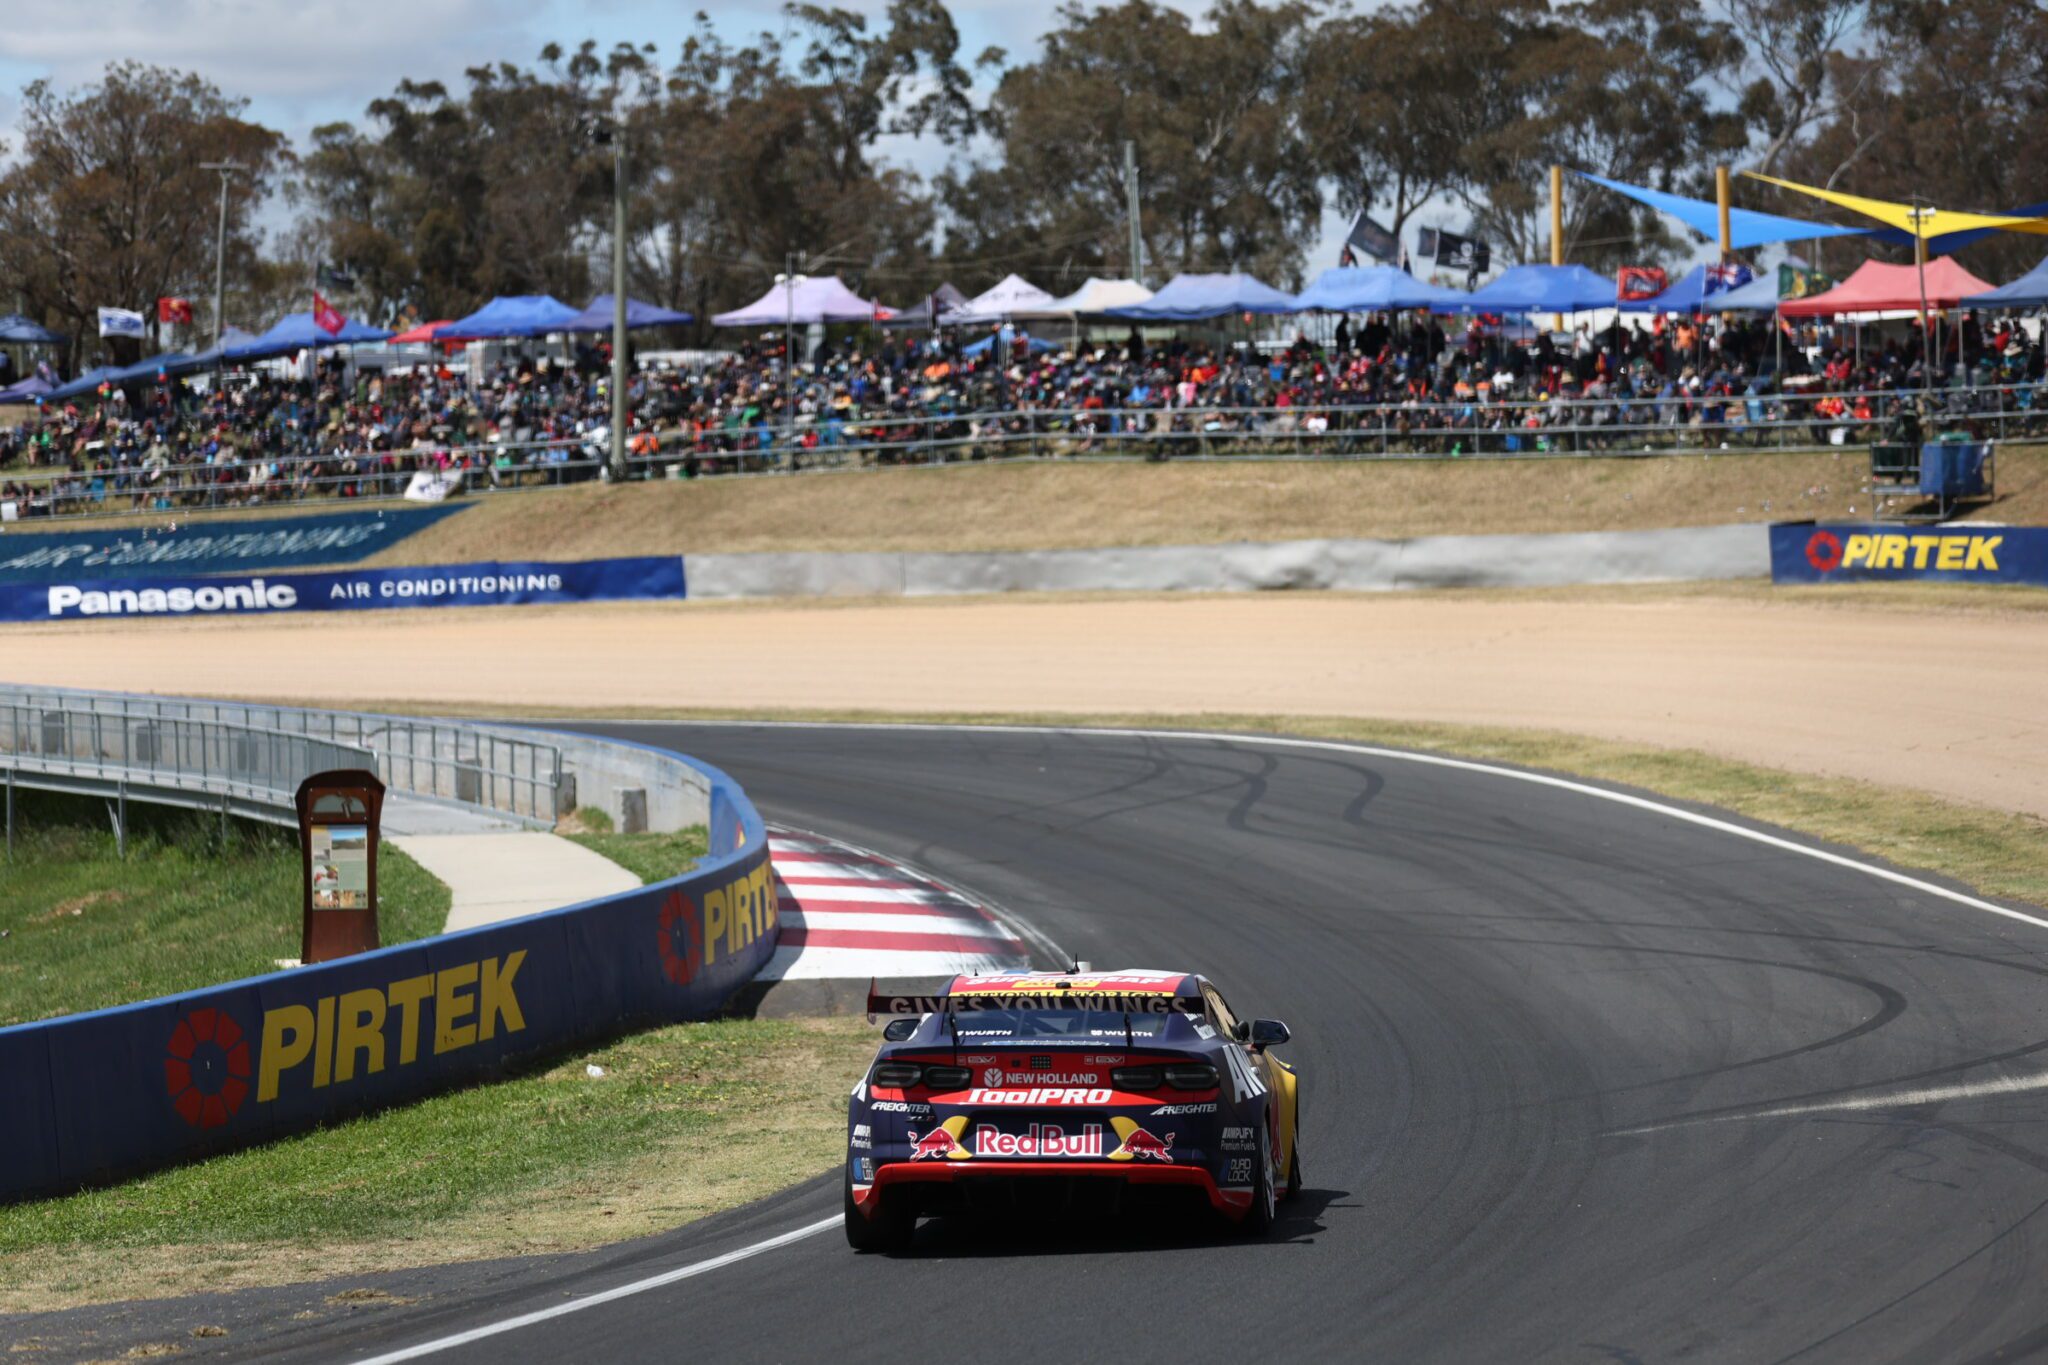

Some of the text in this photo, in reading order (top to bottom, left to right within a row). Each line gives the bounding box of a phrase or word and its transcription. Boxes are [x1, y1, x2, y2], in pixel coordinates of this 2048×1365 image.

[1841, 533, 2004, 571] PIRTEK
[48, 574, 563, 616] Panasonic AIR CONDITIONING
[703, 857, 778, 966] PIRTE
[889, 996, 1189, 1014] GIVES YOU WINGS
[256, 948, 528, 1103] PIRTEK
[1006, 1073, 1098, 1085] NEW HOLLAND
[873, 1101, 931, 1114] FREIGHTER
[1157, 1103, 1218, 1116] FREIGHTER
[976, 1122, 1103, 1156] Red Bull
[1225, 1127, 1254, 1139] AMPLIFY
[1227, 1170, 1251, 1182] LOCK
